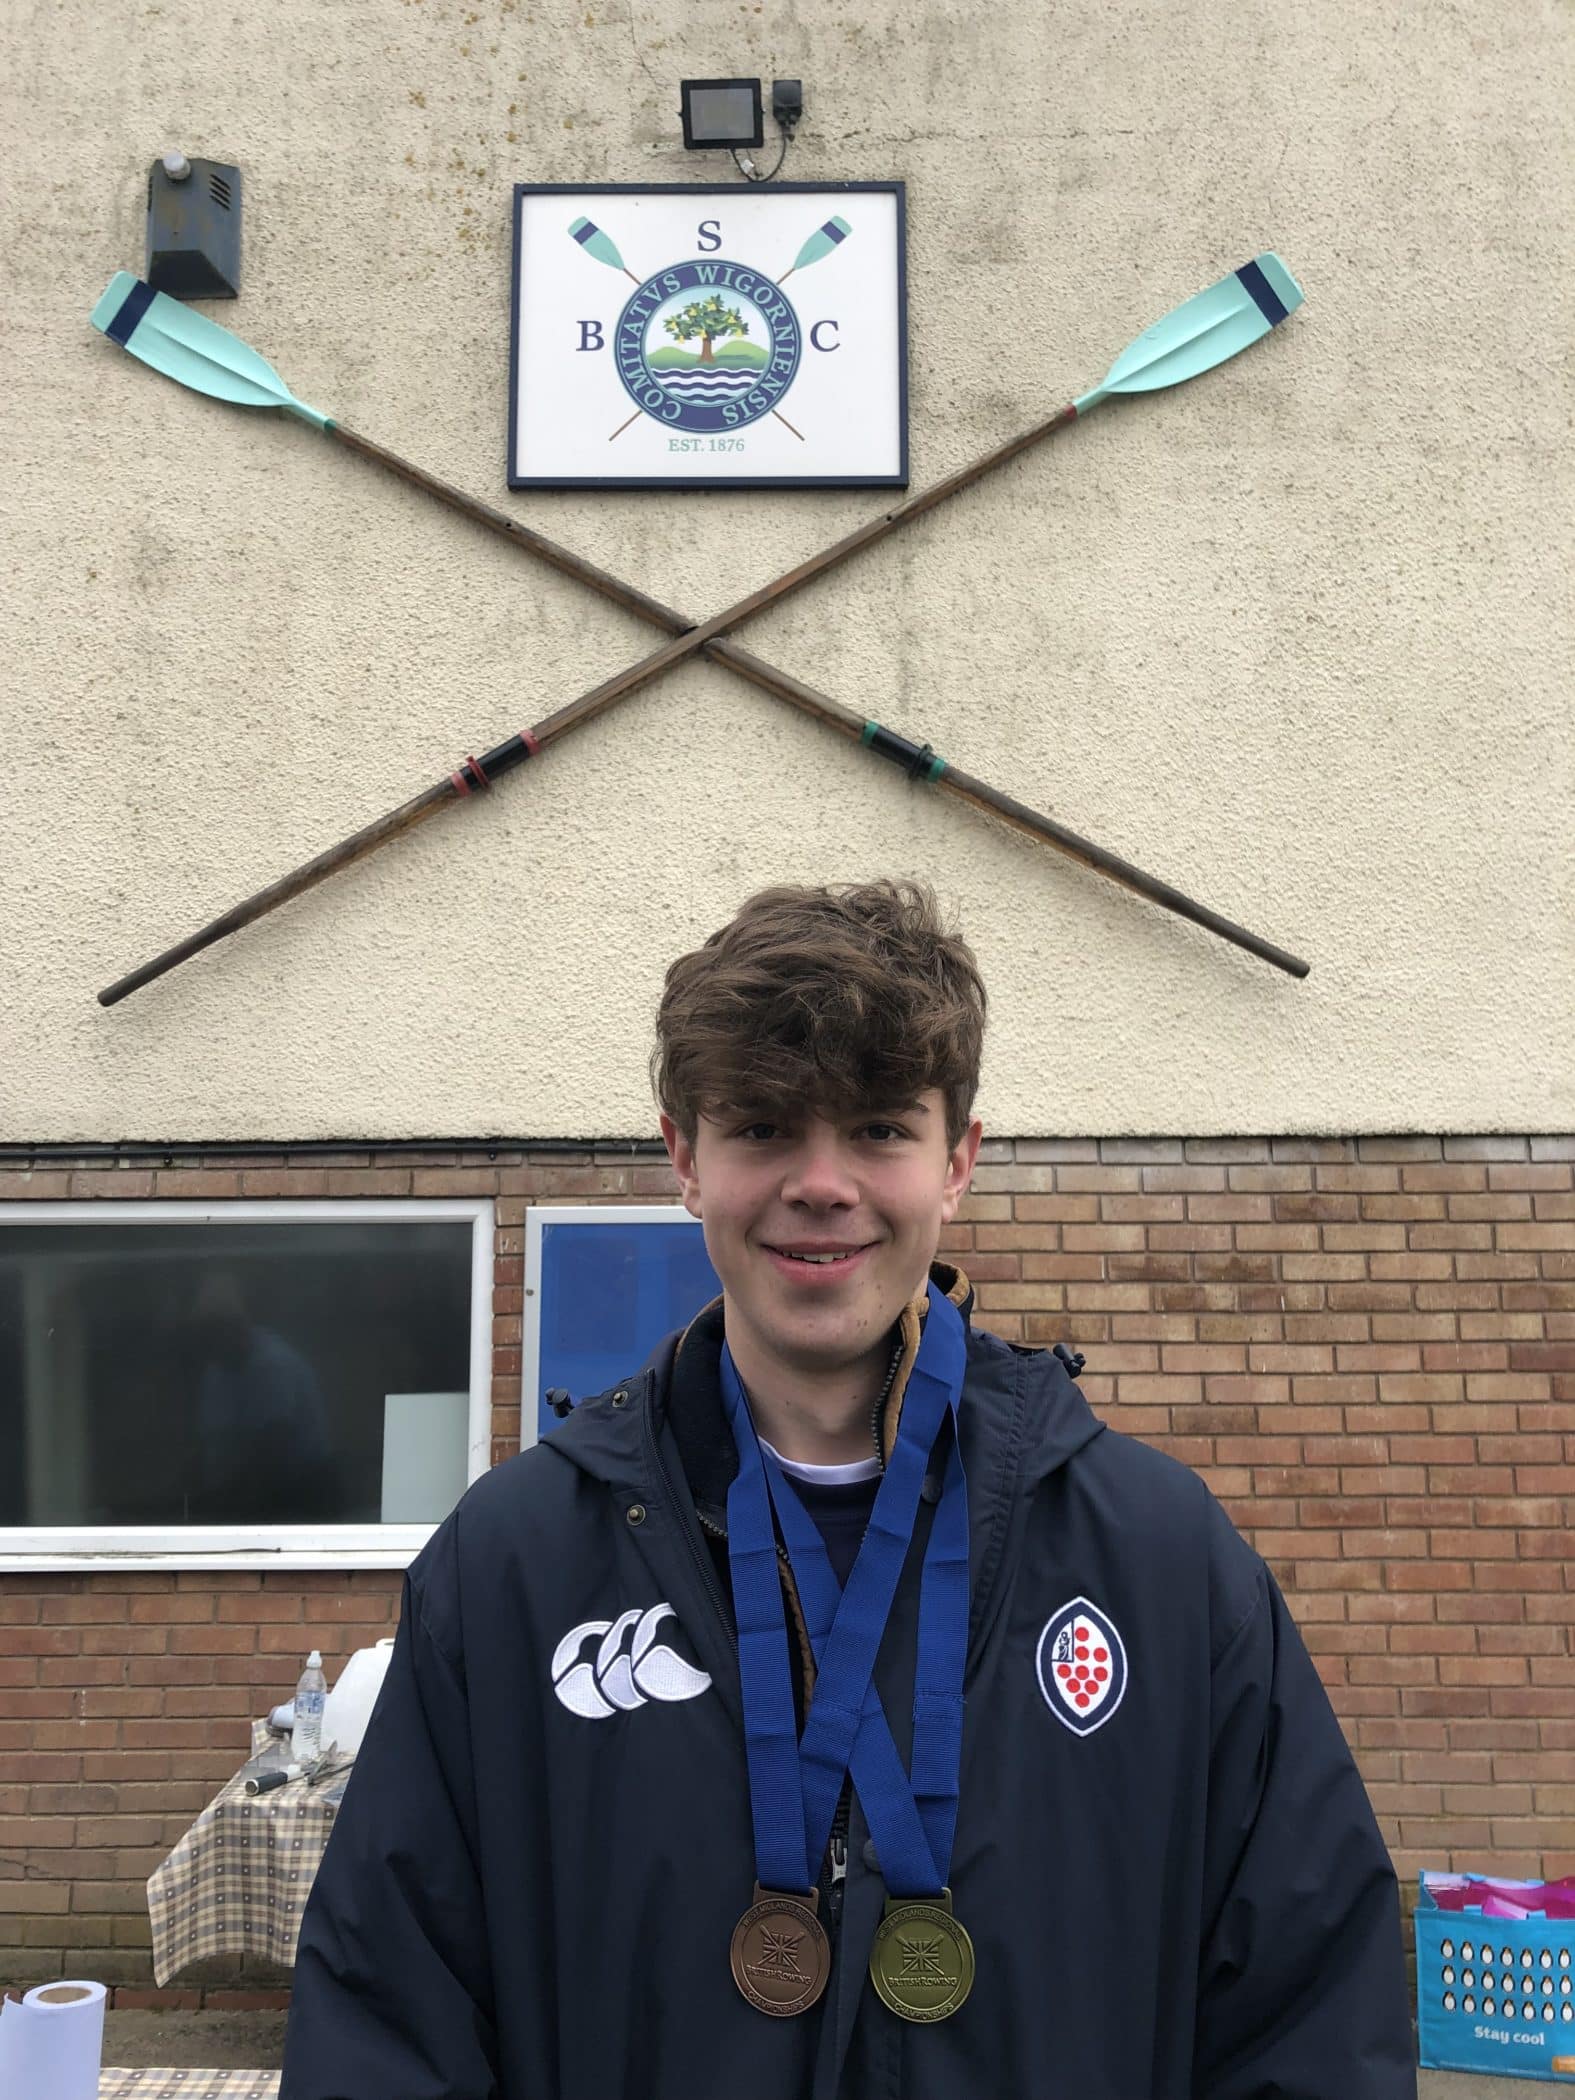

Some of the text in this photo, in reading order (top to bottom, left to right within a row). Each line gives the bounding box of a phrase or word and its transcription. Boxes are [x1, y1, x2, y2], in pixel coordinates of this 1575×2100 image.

[697, 220, 723, 252] S
[576, 320, 605, 352] B
[620, 265, 796, 425] COMITATVS WIGORNIENSIS
[810, 320, 841, 352] C
[668, 438, 745, 453] EST. 1876
[1474, 2025, 1545, 2046] Stay cool
